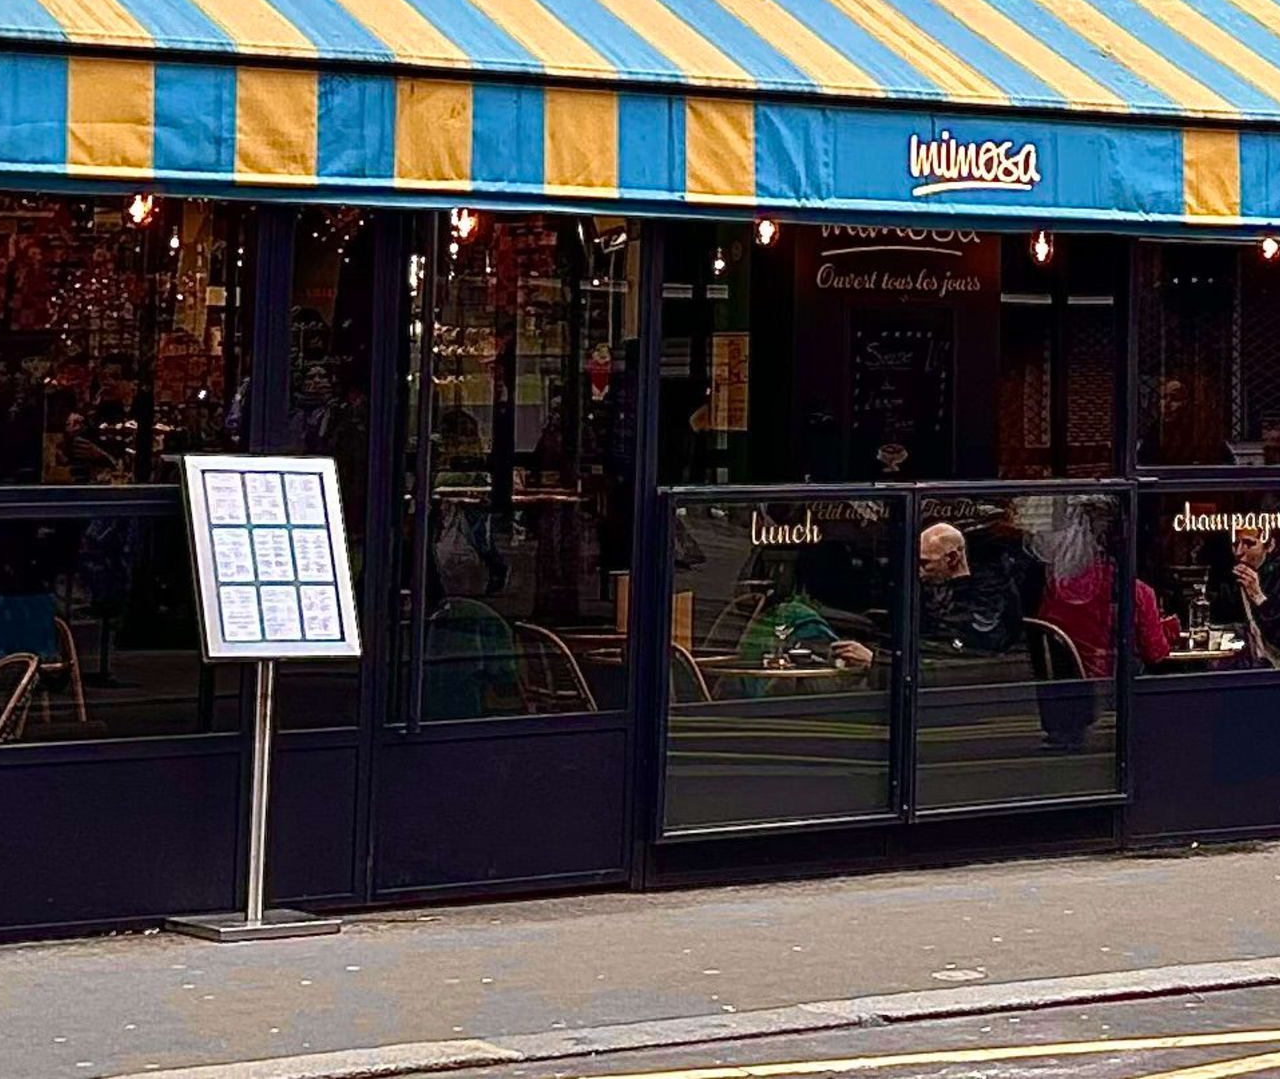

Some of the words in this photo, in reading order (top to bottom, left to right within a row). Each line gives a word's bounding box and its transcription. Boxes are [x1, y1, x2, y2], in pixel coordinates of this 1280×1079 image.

[909, 130, 1041, 183] mimosa
[816, 263, 877, 290] Ouvert
[940, 271, 982, 298] jours
[751, 508, 823, 545] lunch
